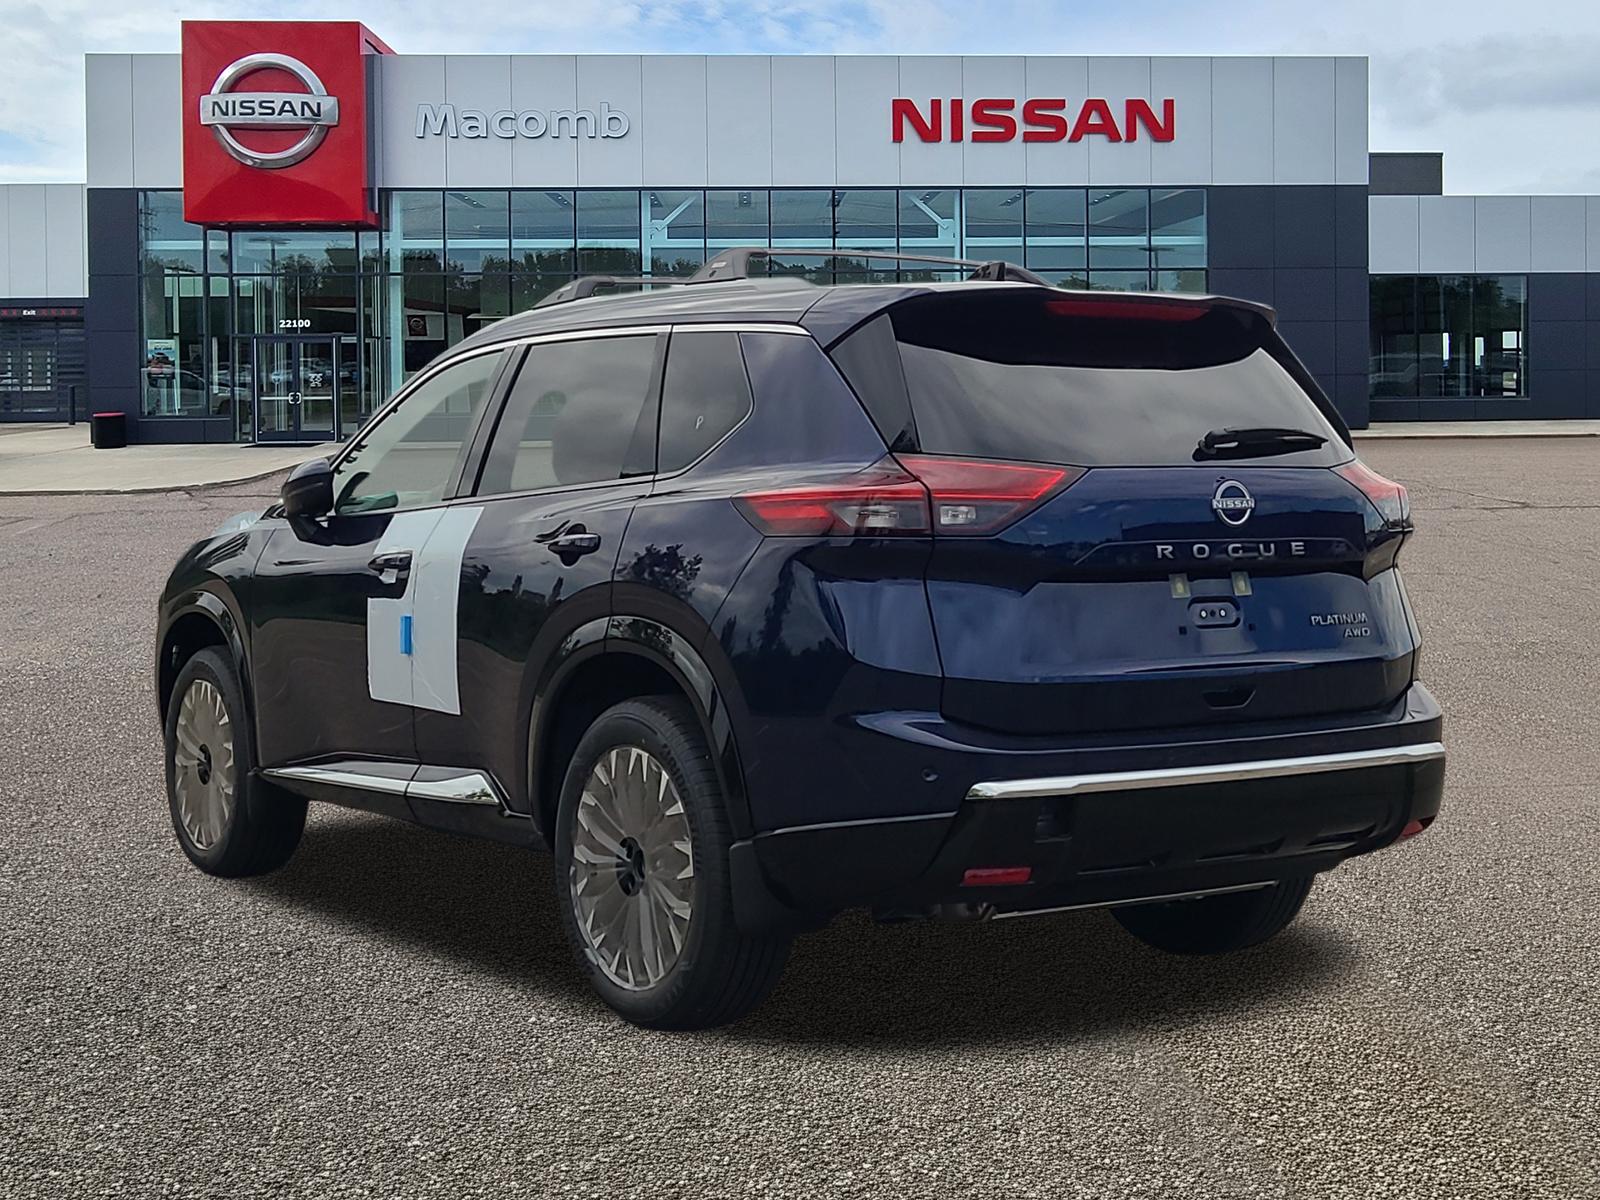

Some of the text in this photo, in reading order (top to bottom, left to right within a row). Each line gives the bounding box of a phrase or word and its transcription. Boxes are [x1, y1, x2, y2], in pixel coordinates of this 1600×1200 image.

[212, 100, 322, 117] NISSAN
[415, 102, 630, 138] Macomb
[892, 98, 1175, 143] NISSAN
[279, 319, 311, 328] 22100
[1212, 498, 1255, 509] NISSAN
[1156, 541, 1305, 559] ROGUE
[1310, 612, 1368, 626] PLATINUM
[1344, 627, 1371, 638] AWD
